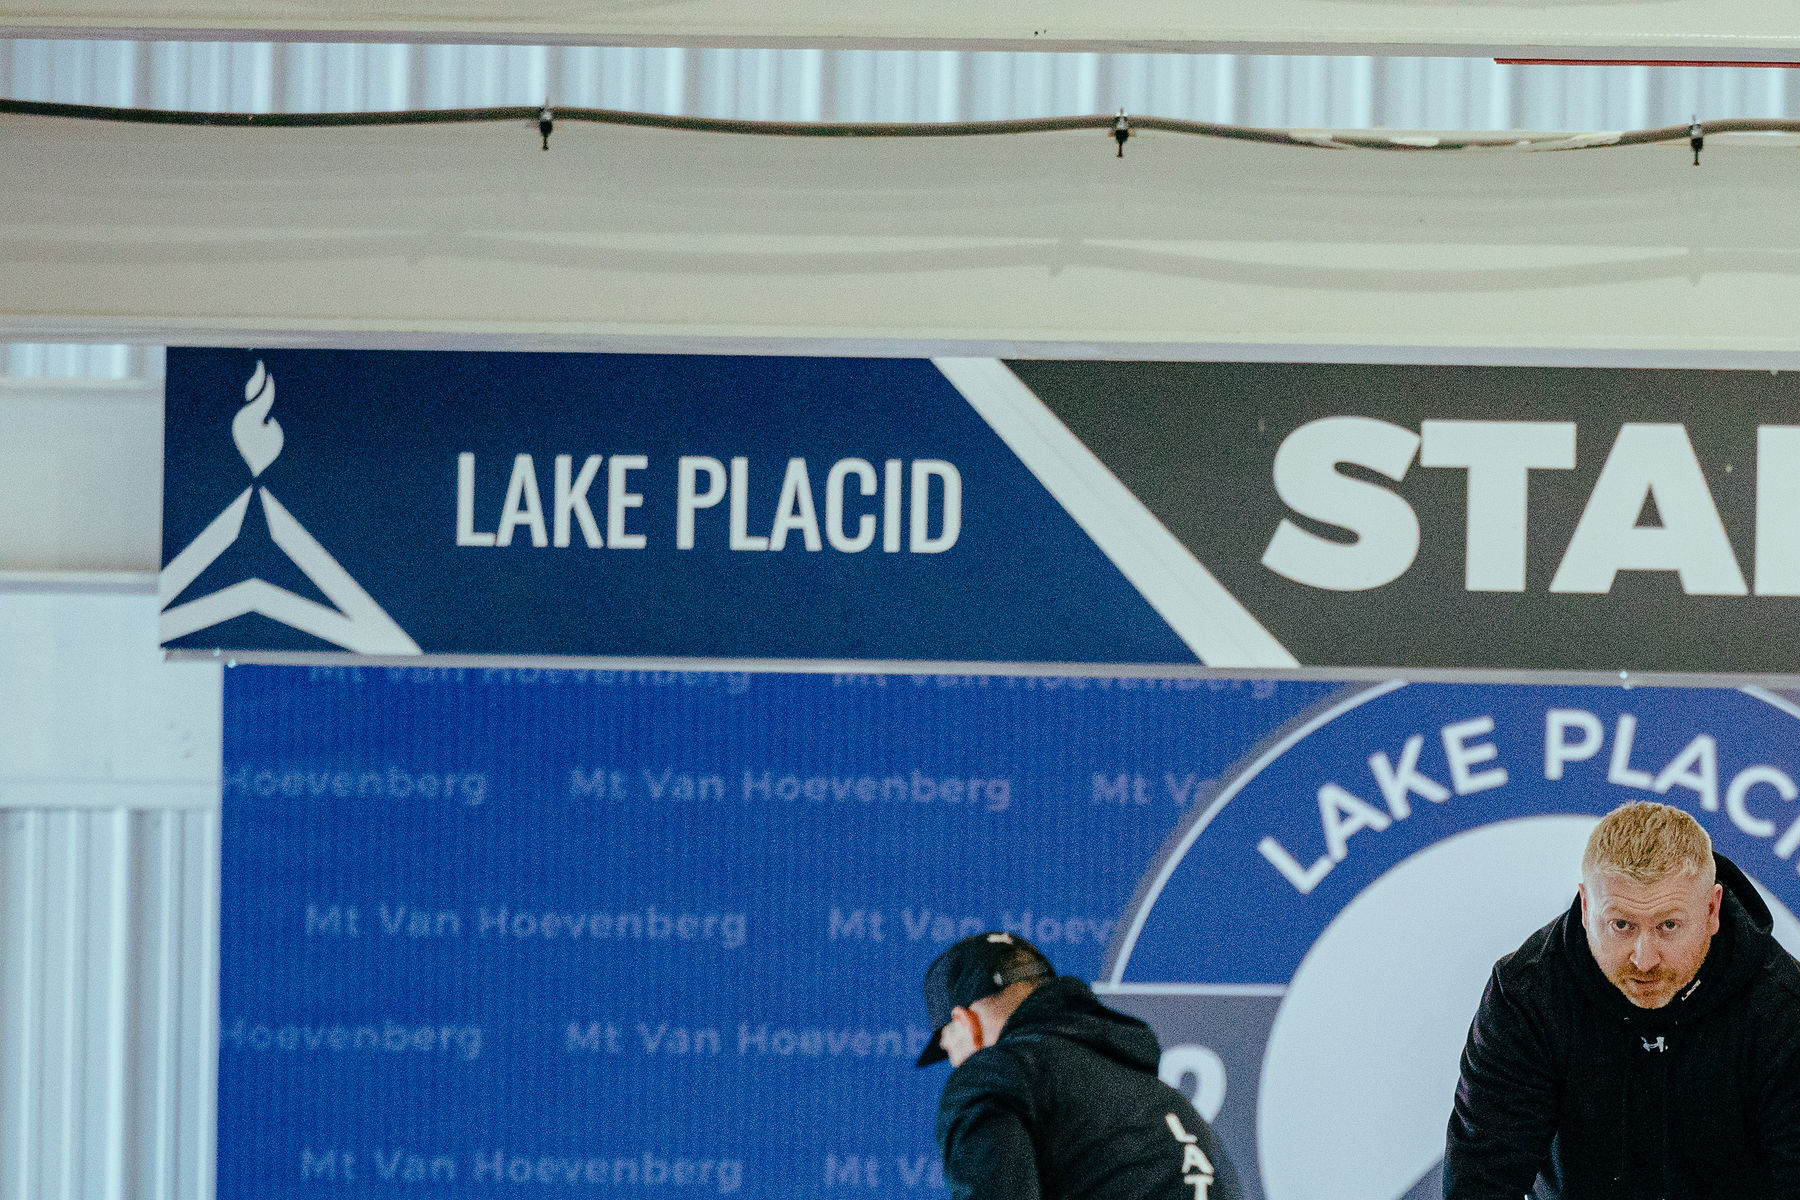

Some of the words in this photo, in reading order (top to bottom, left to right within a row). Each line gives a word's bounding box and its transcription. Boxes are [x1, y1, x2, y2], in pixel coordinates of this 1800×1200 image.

[455, 451, 649, 549] LAKE
[676, 456, 964, 554] PLACID
[570, 766, 627, 800] Mt
[642, 767, 725, 801] Van
[742, 769, 1012, 813] Hoevenberg
[1091, 771, 1152, 805] Mt
[1256, 715, 1509, 896] LAKE
[305, 902, 360, 937] Mt
[379, 902, 461, 937] Van
[478, 903, 747, 949] Hoevenberg
[829, 906, 885, 943] Mt
[566, 1020, 621, 1054] Mt
[637, 1021, 720, 1055] Van
[302, 1148, 354, 1182] Mt
[374, 1149, 456, 1183] Van
[474, 1150, 743, 1195] Hoevenberg
[824, 1152, 879, 1189] Mt
